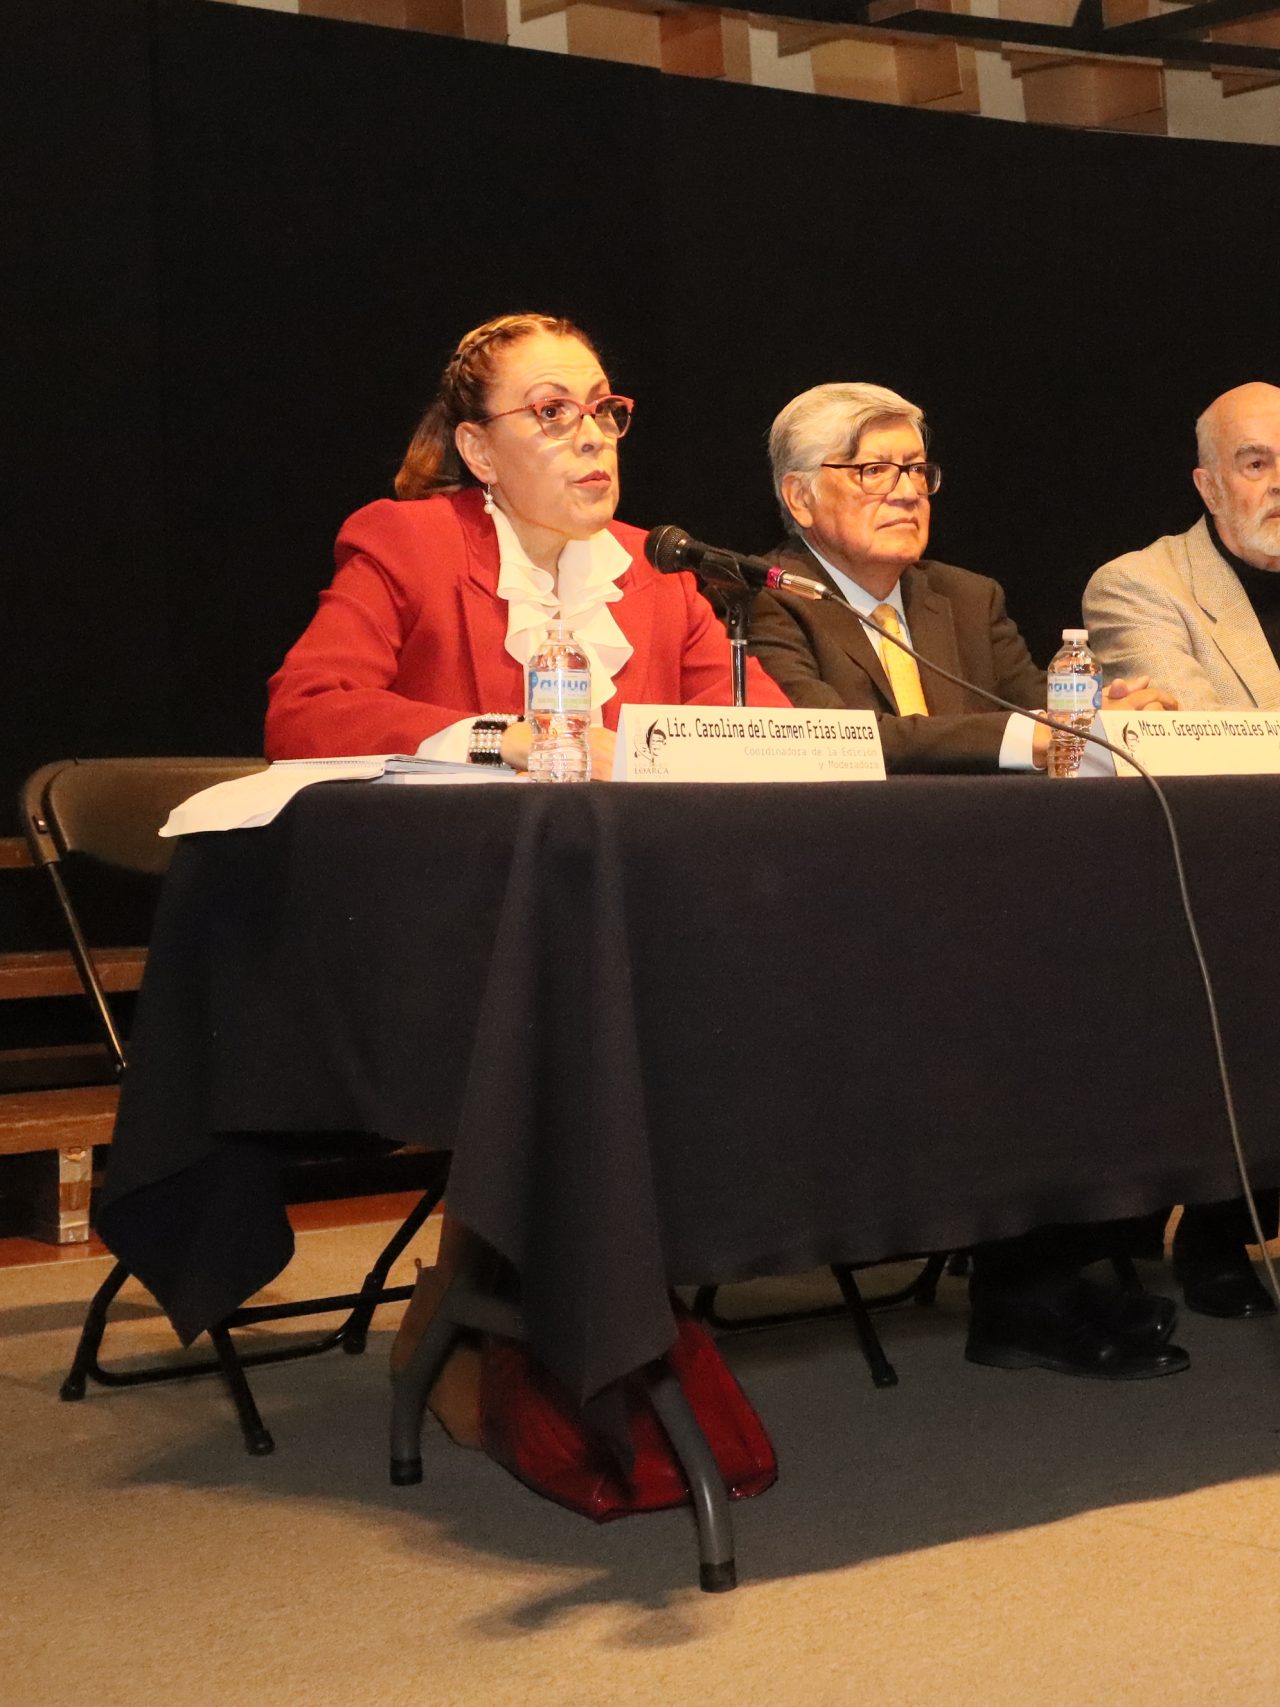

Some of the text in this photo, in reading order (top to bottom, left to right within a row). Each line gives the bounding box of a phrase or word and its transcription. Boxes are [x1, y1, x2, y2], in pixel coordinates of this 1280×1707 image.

[667, 717, 874, 740] Lic. Carolina del Carmen Frías Loarca
[1138, 719, 1171, 737] Mtro.
[1172, 719, 1221, 741] Gregorio
[1220, 719, 1265, 737] Morales
[744, 745, 807, 757] Coordinadora
[811, 746, 823, 756] de
[827, 746, 838, 757] la
[634, 767, 670, 775] LOARCA
[818, 760, 880, 771] y Moderadora
